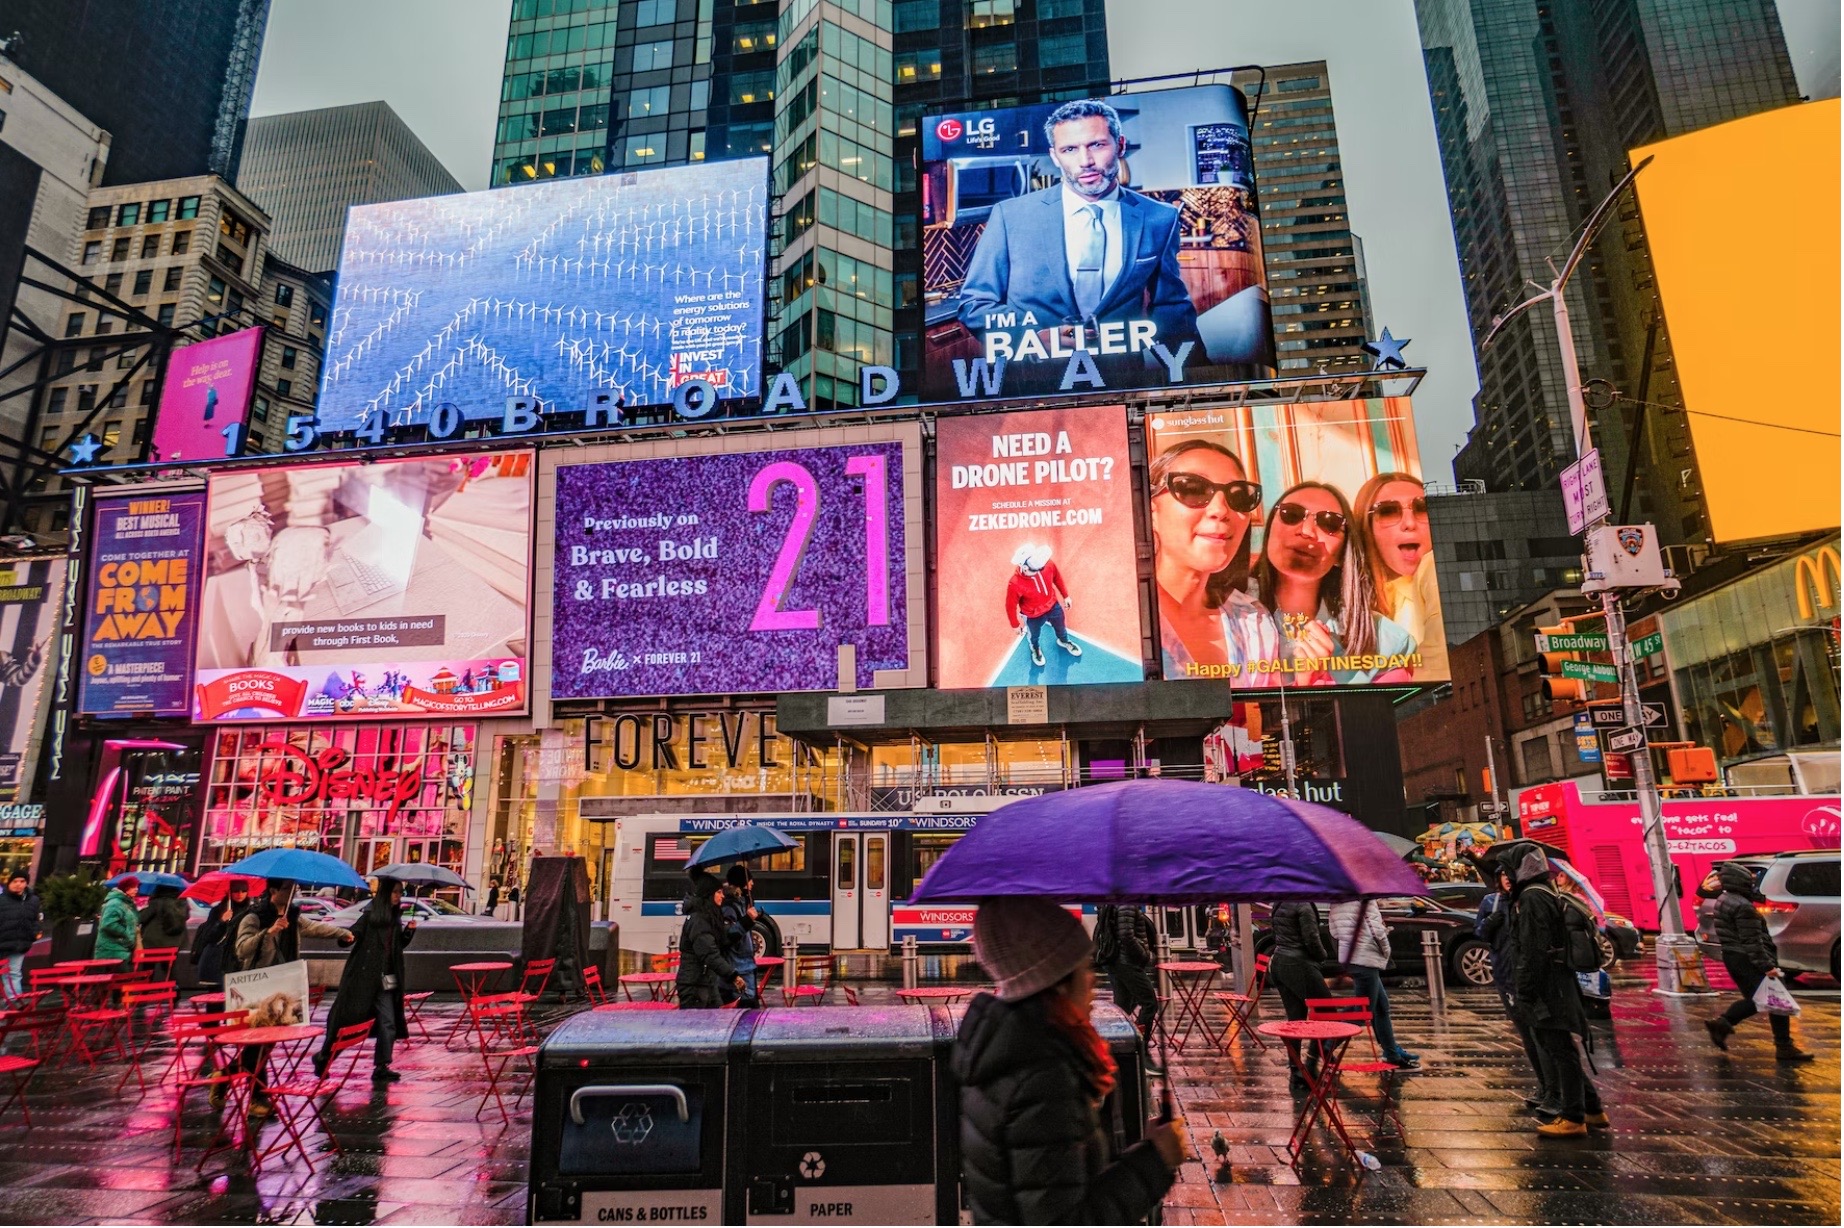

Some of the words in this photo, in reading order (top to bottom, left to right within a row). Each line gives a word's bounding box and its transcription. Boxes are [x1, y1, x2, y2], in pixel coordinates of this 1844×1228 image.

[966, 118, 995, 135] LG
[675, 294, 705, 303] Where
[707, 292, 723, 301] are
[725, 290, 741, 299] the
[673, 305, 707, 315] energy
[708, 301, 750, 312] solutions
[673, 317, 683, 327] of
[685, 314, 732, 325] tomorrow
[985, 312, 1015, 329] I'M
[1022, 311, 1038, 326] A
[681, 325, 712, 336] reality
[714, 322, 747, 333] today?
[986, 320, 1158, 363] BALLER
[680, 350, 724, 361] INVEST
[191, 363, 209, 376] Help
[211, 361, 218, 370] is
[218, 360, 229, 368] on
[680, 363, 692, 373] IN
[183, 378, 196, 388] the
[503, 341, 1195, 433] BROADWAY
[1167, 416, 1207, 428] sunglass
[1207, 415, 1224, 424] hut
[992, 432, 1051, 458] NEED
[1055, 431, 1072, 454] A
[952, 461, 1030, 489] DRONE
[1035, 456, 1114, 484] PILOT?
[1563, 472, 1580, 487] RIGHT
[1582, 458, 1598, 477] LANE
[1572, 481, 1594, 504] MUST
[129, 499, 171, 515] WINNER!
[992, 501, 1027, 510] SCHEDULE
[1034, 499, 1061, 507] MISSION
[1063, 498, 1072, 506] AT
[1570, 510, 1584, 525] TURN
[1587, 496, 1606, 515] RIGHT
[116, 516, 139, 531] BEST
[140, 513, 180, 529] MUSICAL
[584, 512, 673, 532] Previously
[677, 513, 699, 526] on
[968, 508, 1102, 531] ZEKEDRONE.COM
[125, 530, 143, 538] ACROSS
[144, 529, 158, 537] NORTH
[160, 528, 180, 536] AMERICA
[749, 454, 889, 631] 21
[101, 553, 126, 562] COME
[129, 551, 175, 560] TOGETHER
[177, 549, 189, 557] AT
[571, 546, 650, 566] Brave,
[659, 537, 718, 561] Bold
[99, 559, 188, 587] COME
[574, 580, 594, 600] &
[601, 575, 708, 600] Fearless
[92, 611, 185, 641] AWAY
[282, 625, 315, 636] provide
[317, 625, 334, 633] new
[337, 623, 364, 632] books
[367, 622, 377, 631] to
[379, 620, 397, 631] kids
[399, 620, 408, 629] in
[410, 619, 433, 629] need
[313, 637, 349, 647] through
[350, 635, 371, 645] First
[373, 634, 399, 645] Book,
[1552, 636, 1607, 651] Broadway
[1634, 642, 1642, 657] W
[1644, 637, 1654, 653] 45
[581, 648, 629, 674] Barbie
[645, 652, 687, 664] FOREVER
[690, 652, 701, 663] 21
[1186, 662, 1241, 678] Happy
[1247, 653, 1423, 673] #GALENTINESDAY!!
[1564, 662, 1591, 675] George
[1593, 665, 1616, 676] Abbott
[229, 680, 275, 693] BOOKS
[307, 698, 335, 706] MAGIC
[1011, 691, 1044, 699] EVEREST
[340, 700, 354, 708] abc
[413, 695, 515, 711] MAGICOFSTORYTELLING.COM
[1600, 712, 1622, 721] ONE
[1613, 737, 1625, 747] ONE
[1628, 733, 1640, 742] WAY
[257, 742, 421, 822] Disney
[1304, 781, 1343, 802] hut
[0, 804, 43, 819] GAGE
[1685, 814, 1709, 823] gets
[1714, 813, 1738, 823] fed!
[916, 817, 977, 828] WINDSORS
[1718, 825, 1732, 834] to
[920, 912, 974, 922] WINDSORS
[230, 972, 269, 986] ARITZIA
[599, 1207, 633, 1222] CANS
[636, 1208, 647, 1221] &
[650, 1206, 707, 1221] BOTTLES
[810, 1203, 852, 1217] PAPER
